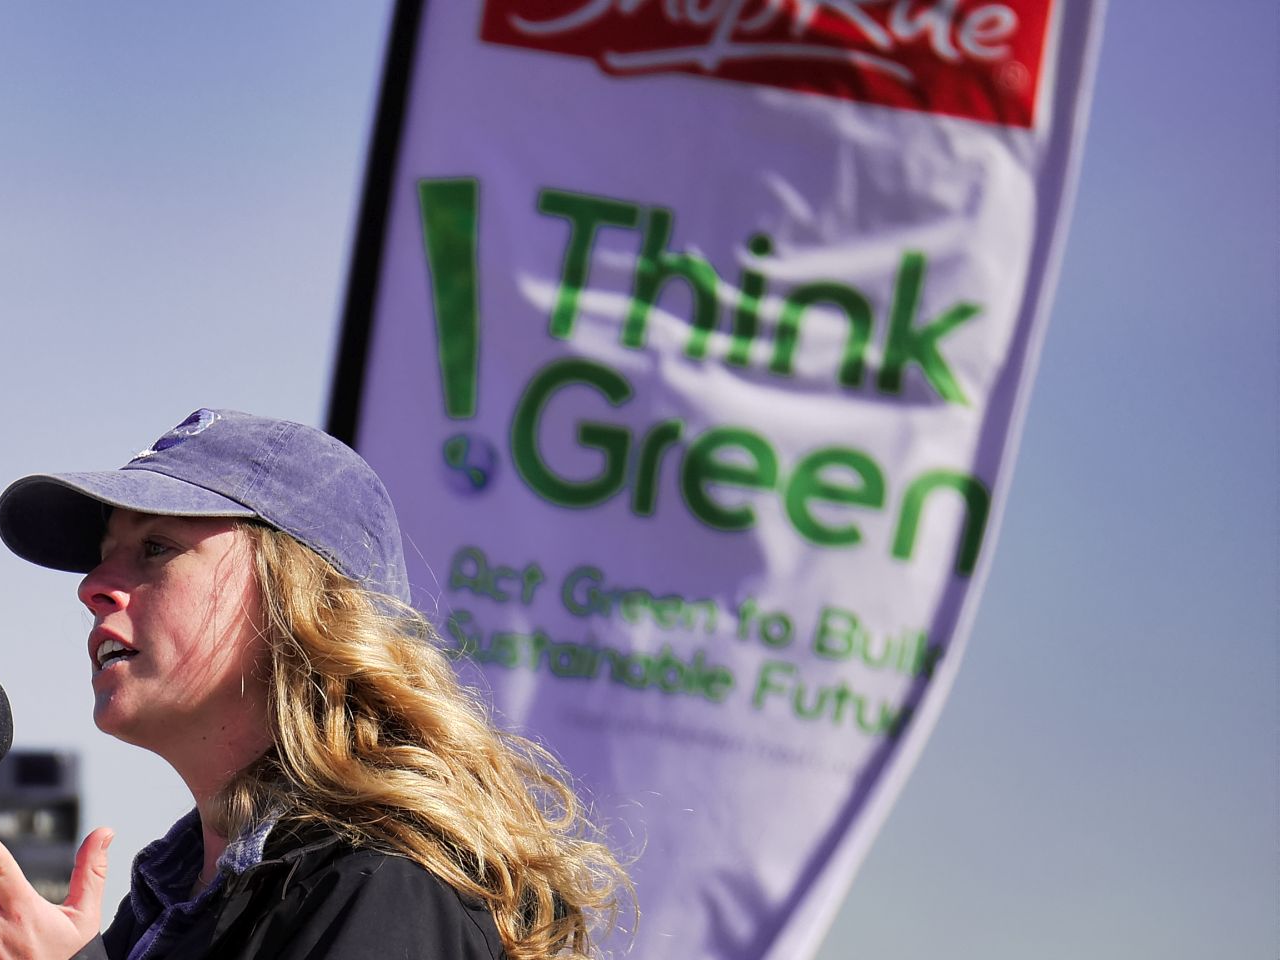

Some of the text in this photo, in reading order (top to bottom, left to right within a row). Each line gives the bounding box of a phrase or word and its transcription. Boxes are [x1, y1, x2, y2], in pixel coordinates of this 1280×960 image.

[536, 186, 983, 407] Think
[510, 356, 992, 577] Green
[446, 609, 734, 701] Sustainable
[450, 546, 544, 605] Act
[562, 565, 716, 632] Green
[736, 593, 793, 648] to
